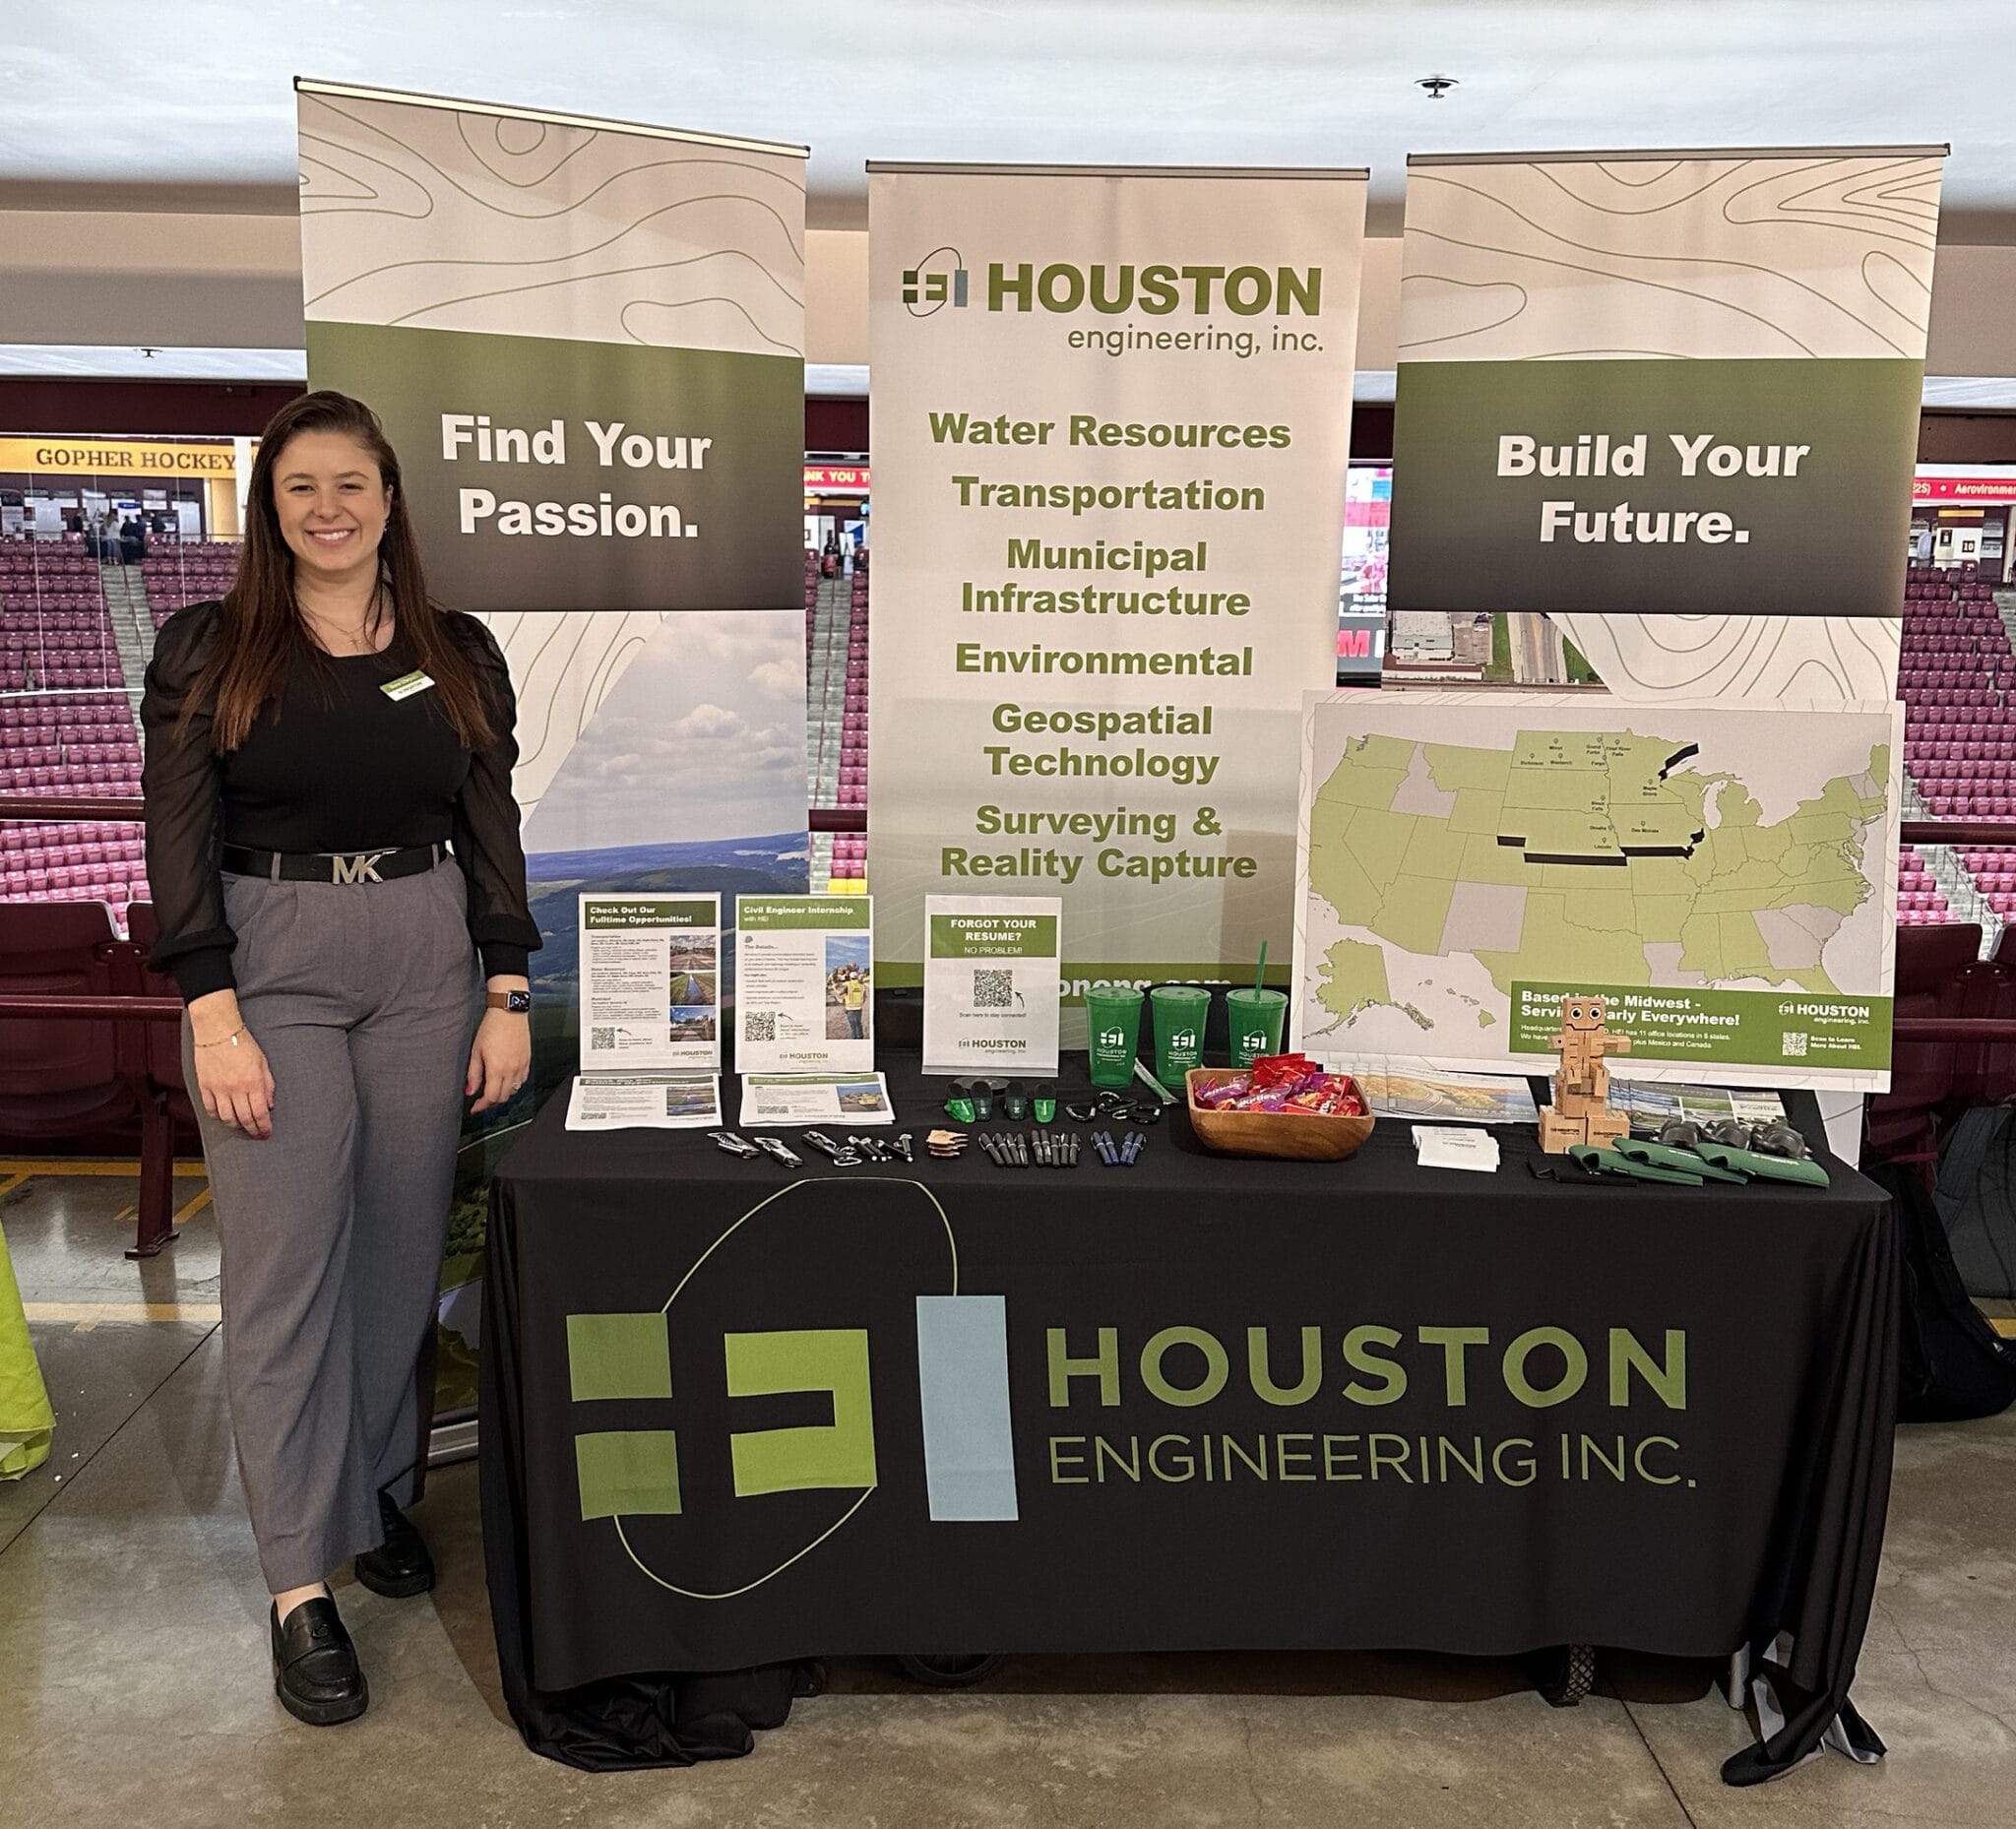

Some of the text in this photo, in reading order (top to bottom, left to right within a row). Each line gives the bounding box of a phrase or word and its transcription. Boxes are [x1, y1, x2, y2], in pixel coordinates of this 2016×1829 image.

[987, 263, 1322, 316] HOUSTON
[1067, 323, 1323, 358] engineering, inc.
[441, 413, 713, 470] Find Your
[928, 412, 1292, 449] Water Resources
[35, 449, 236, 471] GOPHER HOCKEY
[1497, 434, 1811, 477] Build Your
[829, 471, 856, 482] YOU
[459, 488, 699, 537] Passion.
[952, 475, 1265, 516] Transportation
[1540, 500, 1750, 544] Future.
[1007, 538, 1208, 579] Municipal
[962, 582, 1251, 616] Infrastructure
[956, 643, 1253, 676] Environmental
[991, 703, 1213, 741] Geospatial
[983, 746, 1221, 786] Technology
[976, 805, 1223, 844] Surveying &
[332, 852, 386, 885] MK
[941, 847, 1258, 885] Reality Capture
[628, 915, 692, 925] Opportunities!
[766, 907, 805, 915] Engineer
[808, 907, 853, 915] Internship
[950, 919, 1037, 929] FORGOT YOUR
[965, 932, 1022, 942] RESUME?
[979, 946, 1023, 955] PROBLEM!
[1624, 994, 1691, 1009] Midwest
[1641, 1010, 1740, 1026] Everywhere!
[1796, 1003, 1870, 1018] HOUSTON
[972, 1040, 1027, 1048] HOUSTON
[1046, 1324, 1687, 1411] HOUSTON
[1049, 1432, 1697, 1488] ENGINEERING INC.
